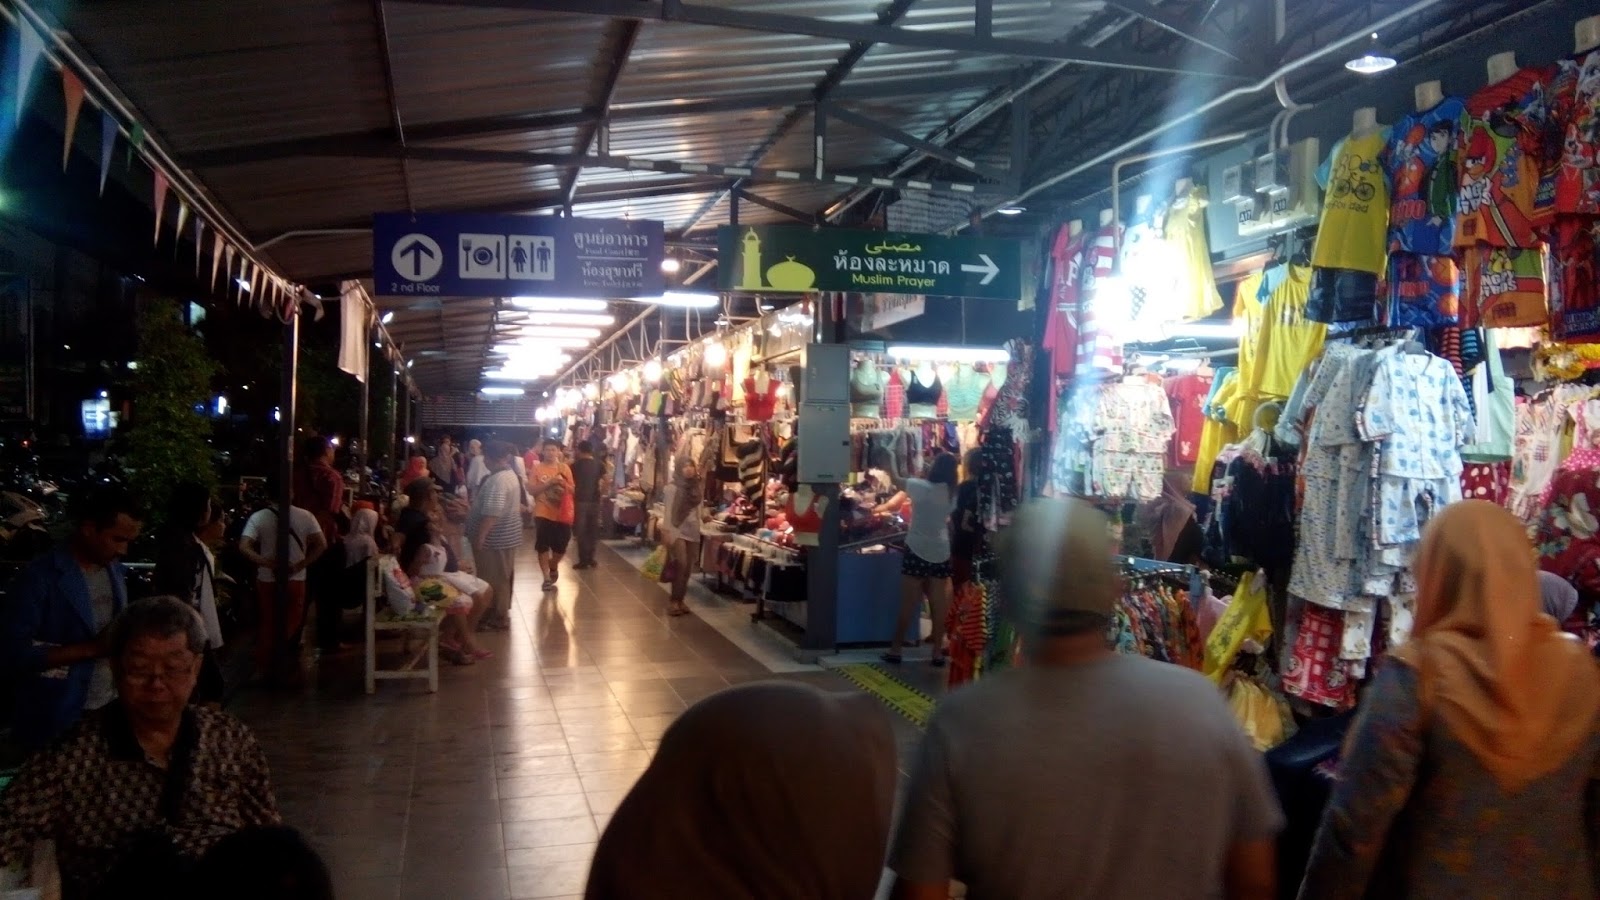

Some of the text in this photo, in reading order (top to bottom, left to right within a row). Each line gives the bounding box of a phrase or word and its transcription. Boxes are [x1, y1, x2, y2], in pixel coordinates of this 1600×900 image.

[833, 249, 950, 275] ห้องละหมาด
[391, 282, 440, 293] 2 nd Floor
[852, 273, 935, 289] Muslim Prayer
